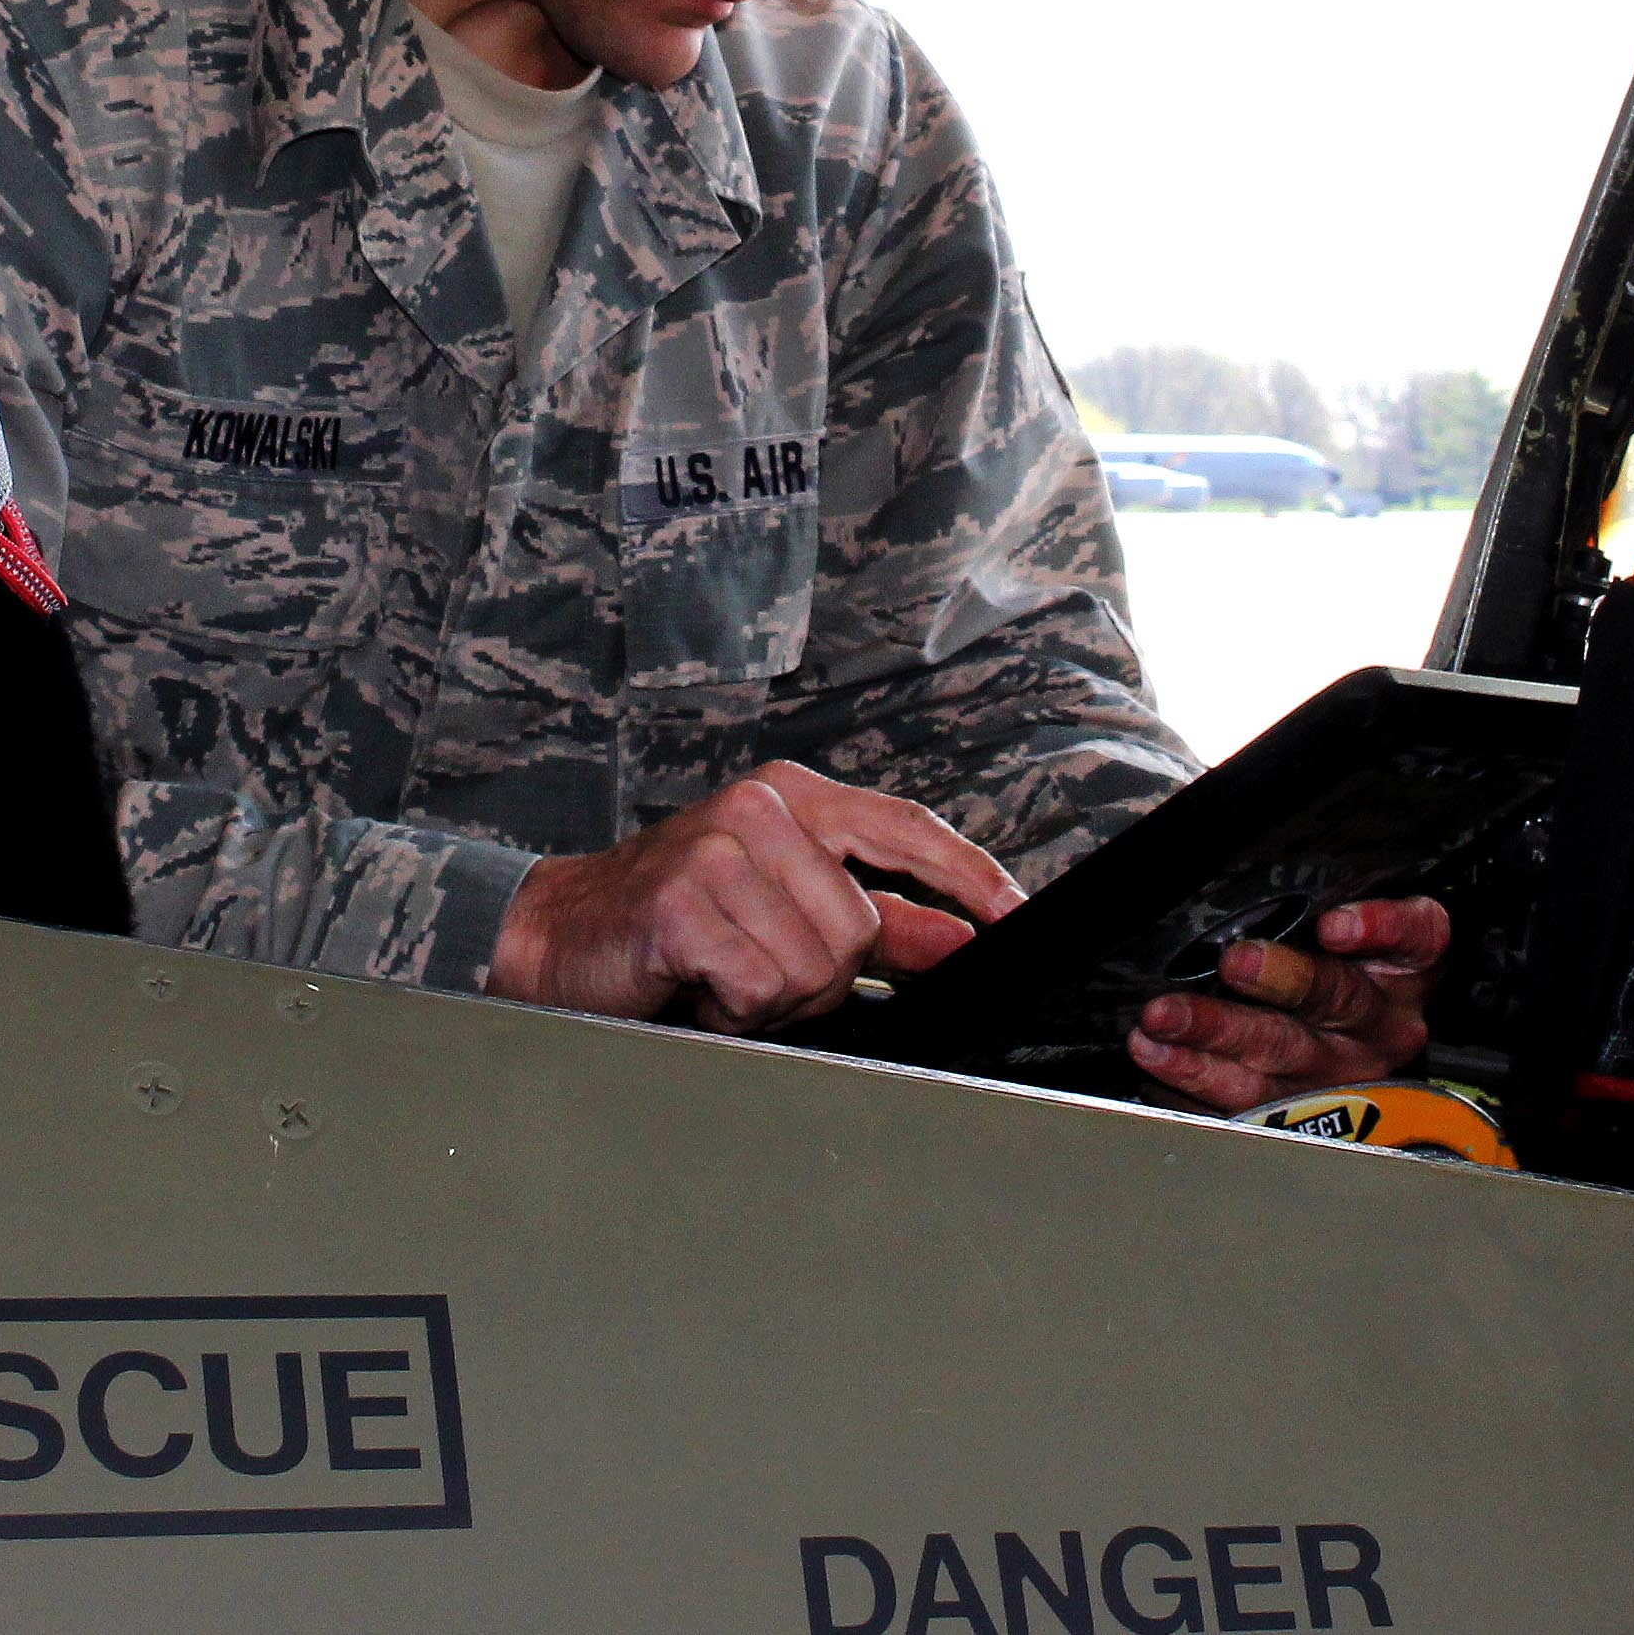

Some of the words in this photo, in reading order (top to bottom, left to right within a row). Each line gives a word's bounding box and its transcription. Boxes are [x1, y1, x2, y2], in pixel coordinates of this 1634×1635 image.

[183, 408, 342, 470] KOWALSKI
[655, 452, 731, 508] U.S.
[744, 441, 806, 499] AIR
[798, 1522, 1395, 1635] DANGER
